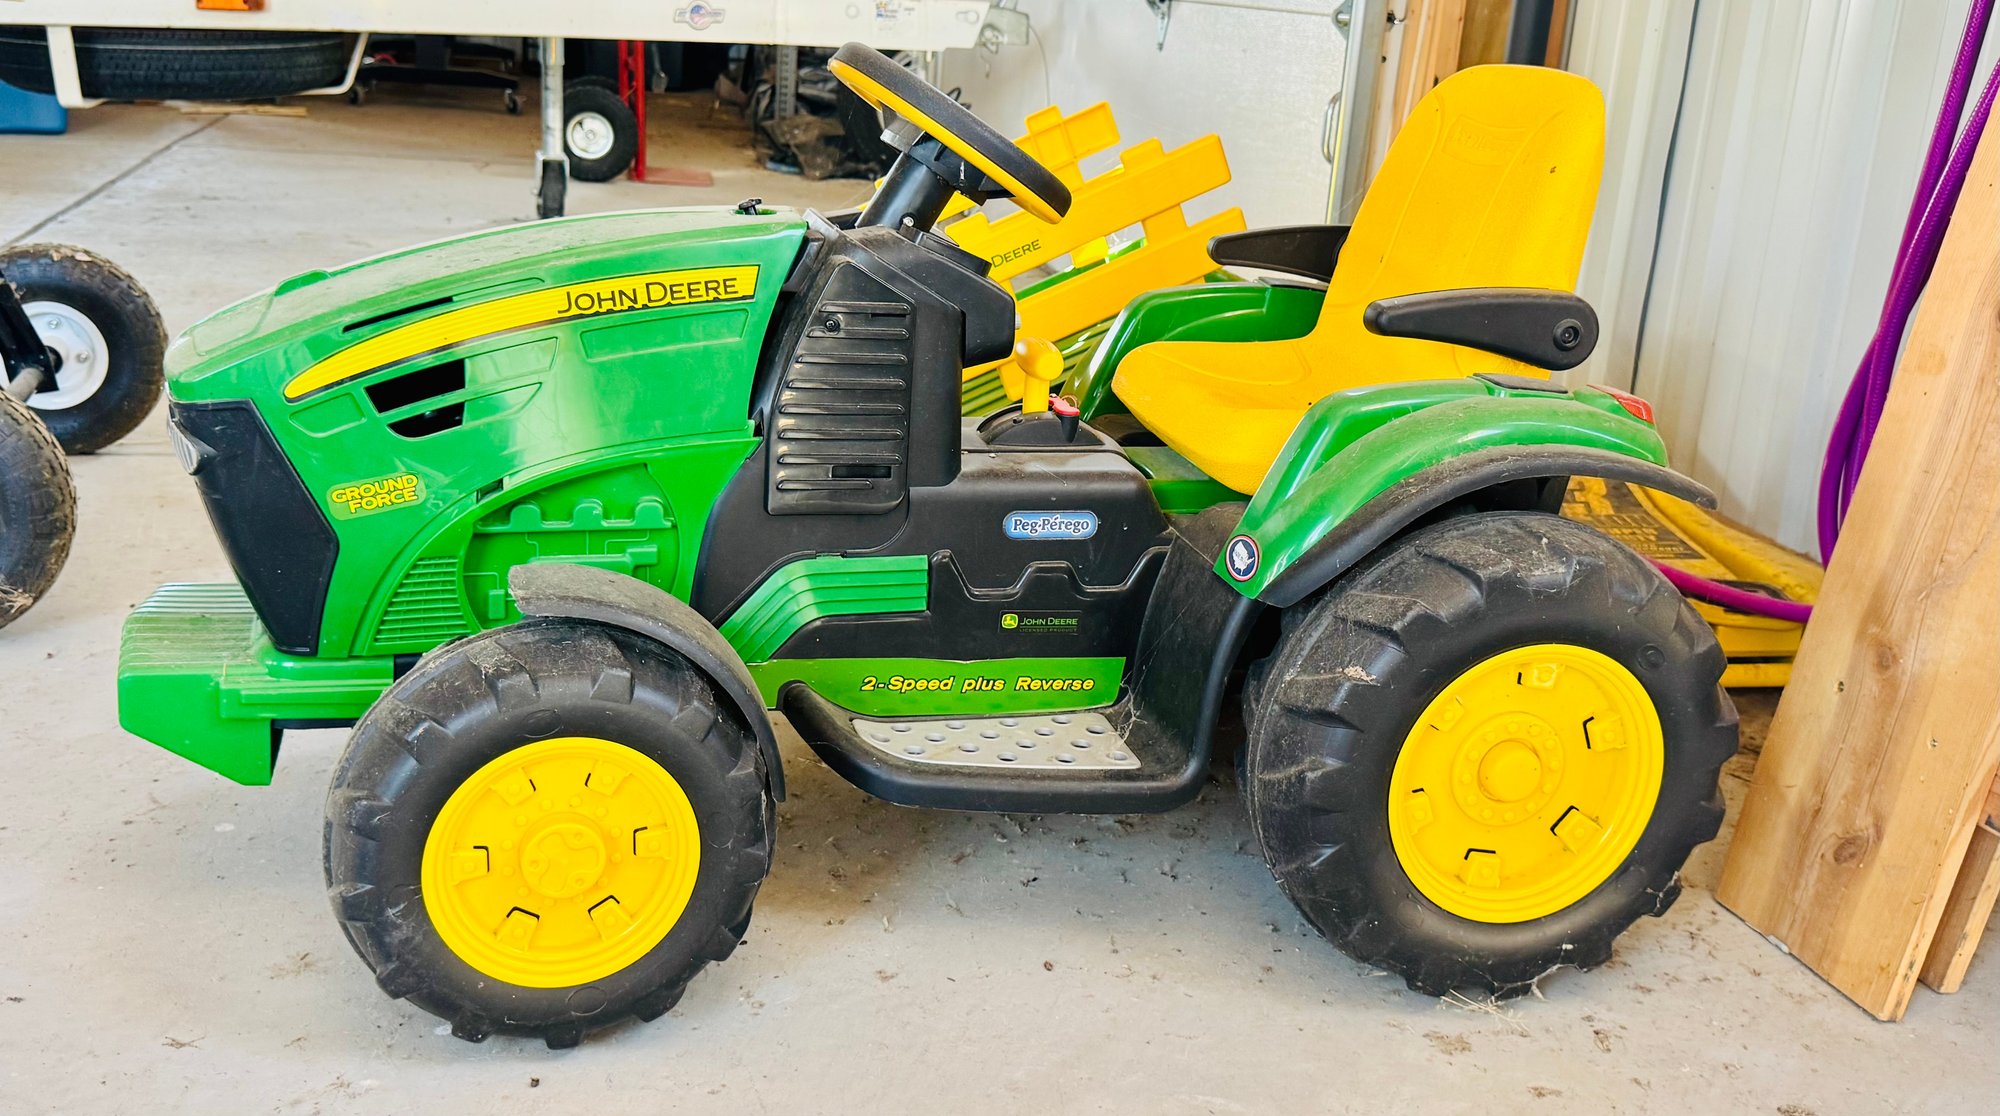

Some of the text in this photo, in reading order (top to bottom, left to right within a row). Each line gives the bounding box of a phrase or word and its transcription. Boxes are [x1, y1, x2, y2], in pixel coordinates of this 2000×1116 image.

[990, 239, 1042, 268] DEERE
[557, 277, 739, 314] JOHN DEERE
[331, 474, 418, 503] GROUND
[348, 486, 418, 514] FORCE
[1020, 617, 1078, 625] JOHN DEERE
[861, 675, 1095, 693] 2-Speed plus Reverse
